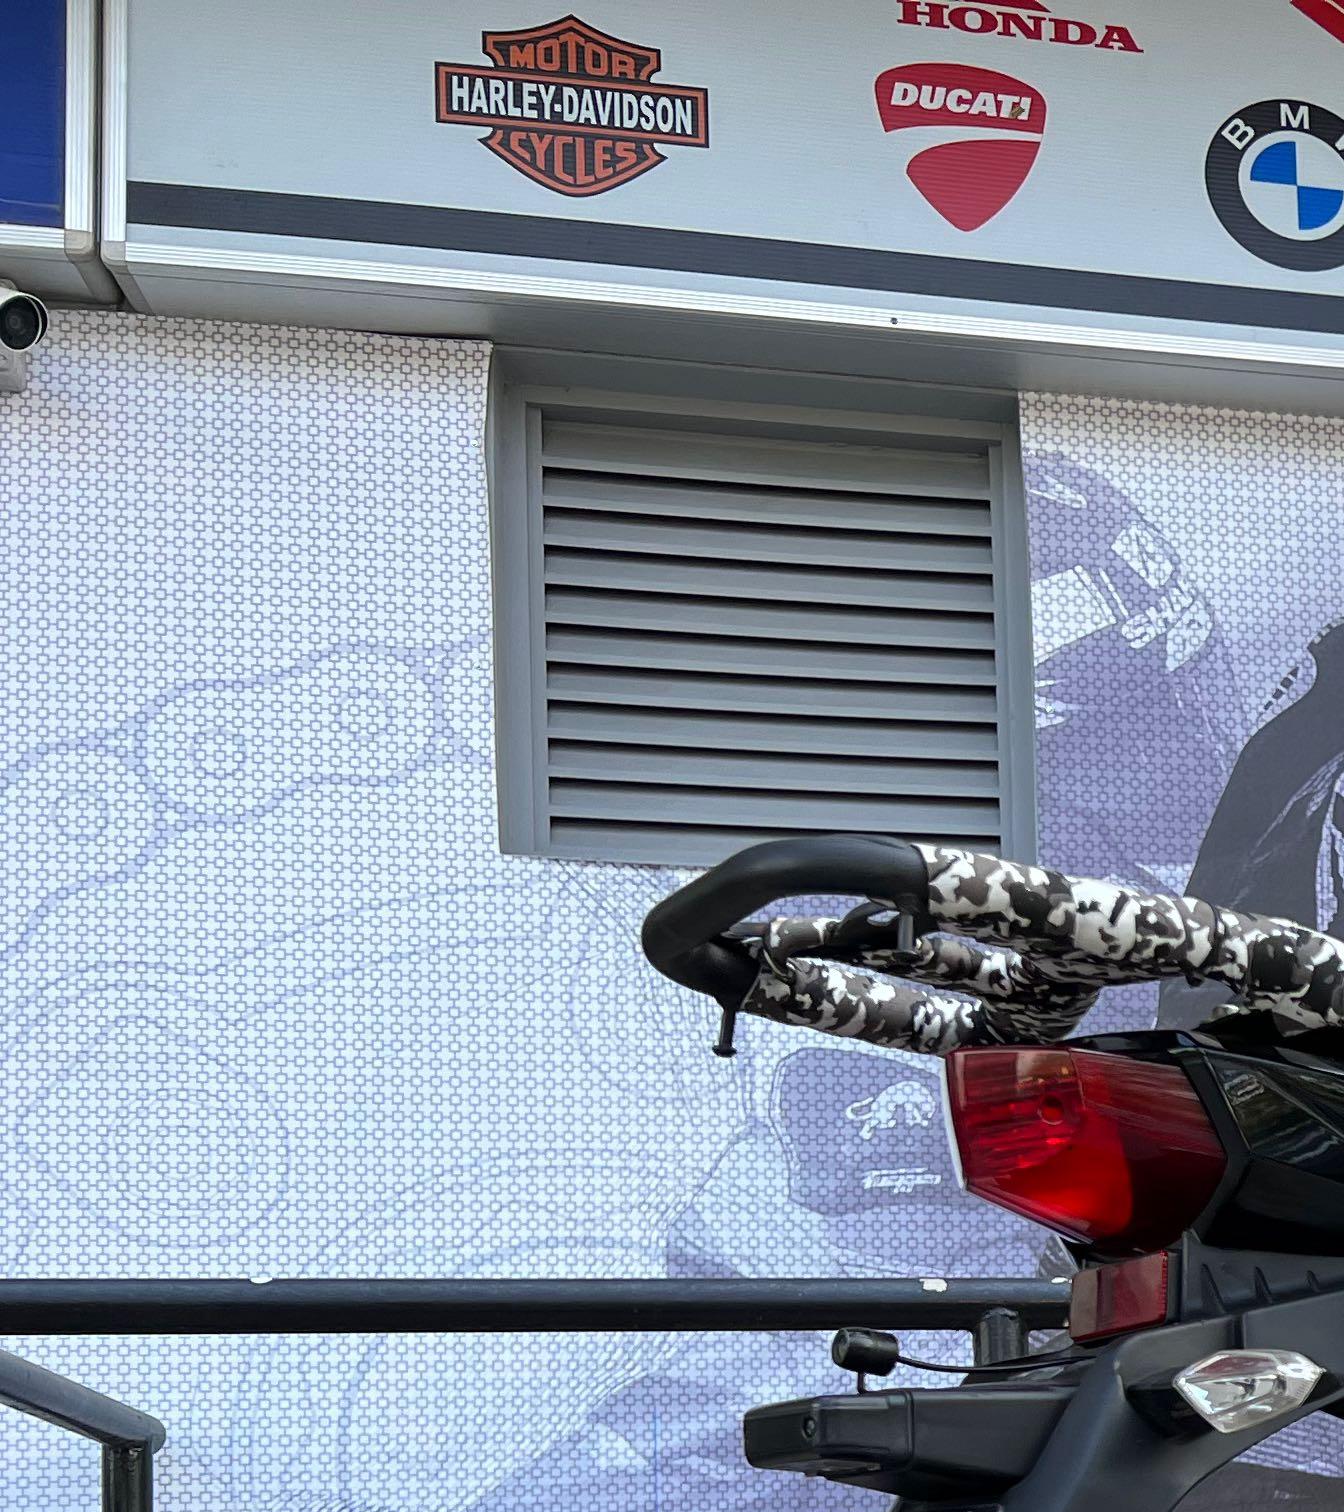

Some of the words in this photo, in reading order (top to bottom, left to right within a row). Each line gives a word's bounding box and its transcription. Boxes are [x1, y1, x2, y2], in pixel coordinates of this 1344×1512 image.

[897, 1, 1144, 53] HONDA
[509, 31, 636, 79] MOTOR
[451, 75, 693, 135] HARLEY-DAVIDSON
[890, 81, 1031, 121] DUCATI
[509, 130, 638, 185] CYCLES
